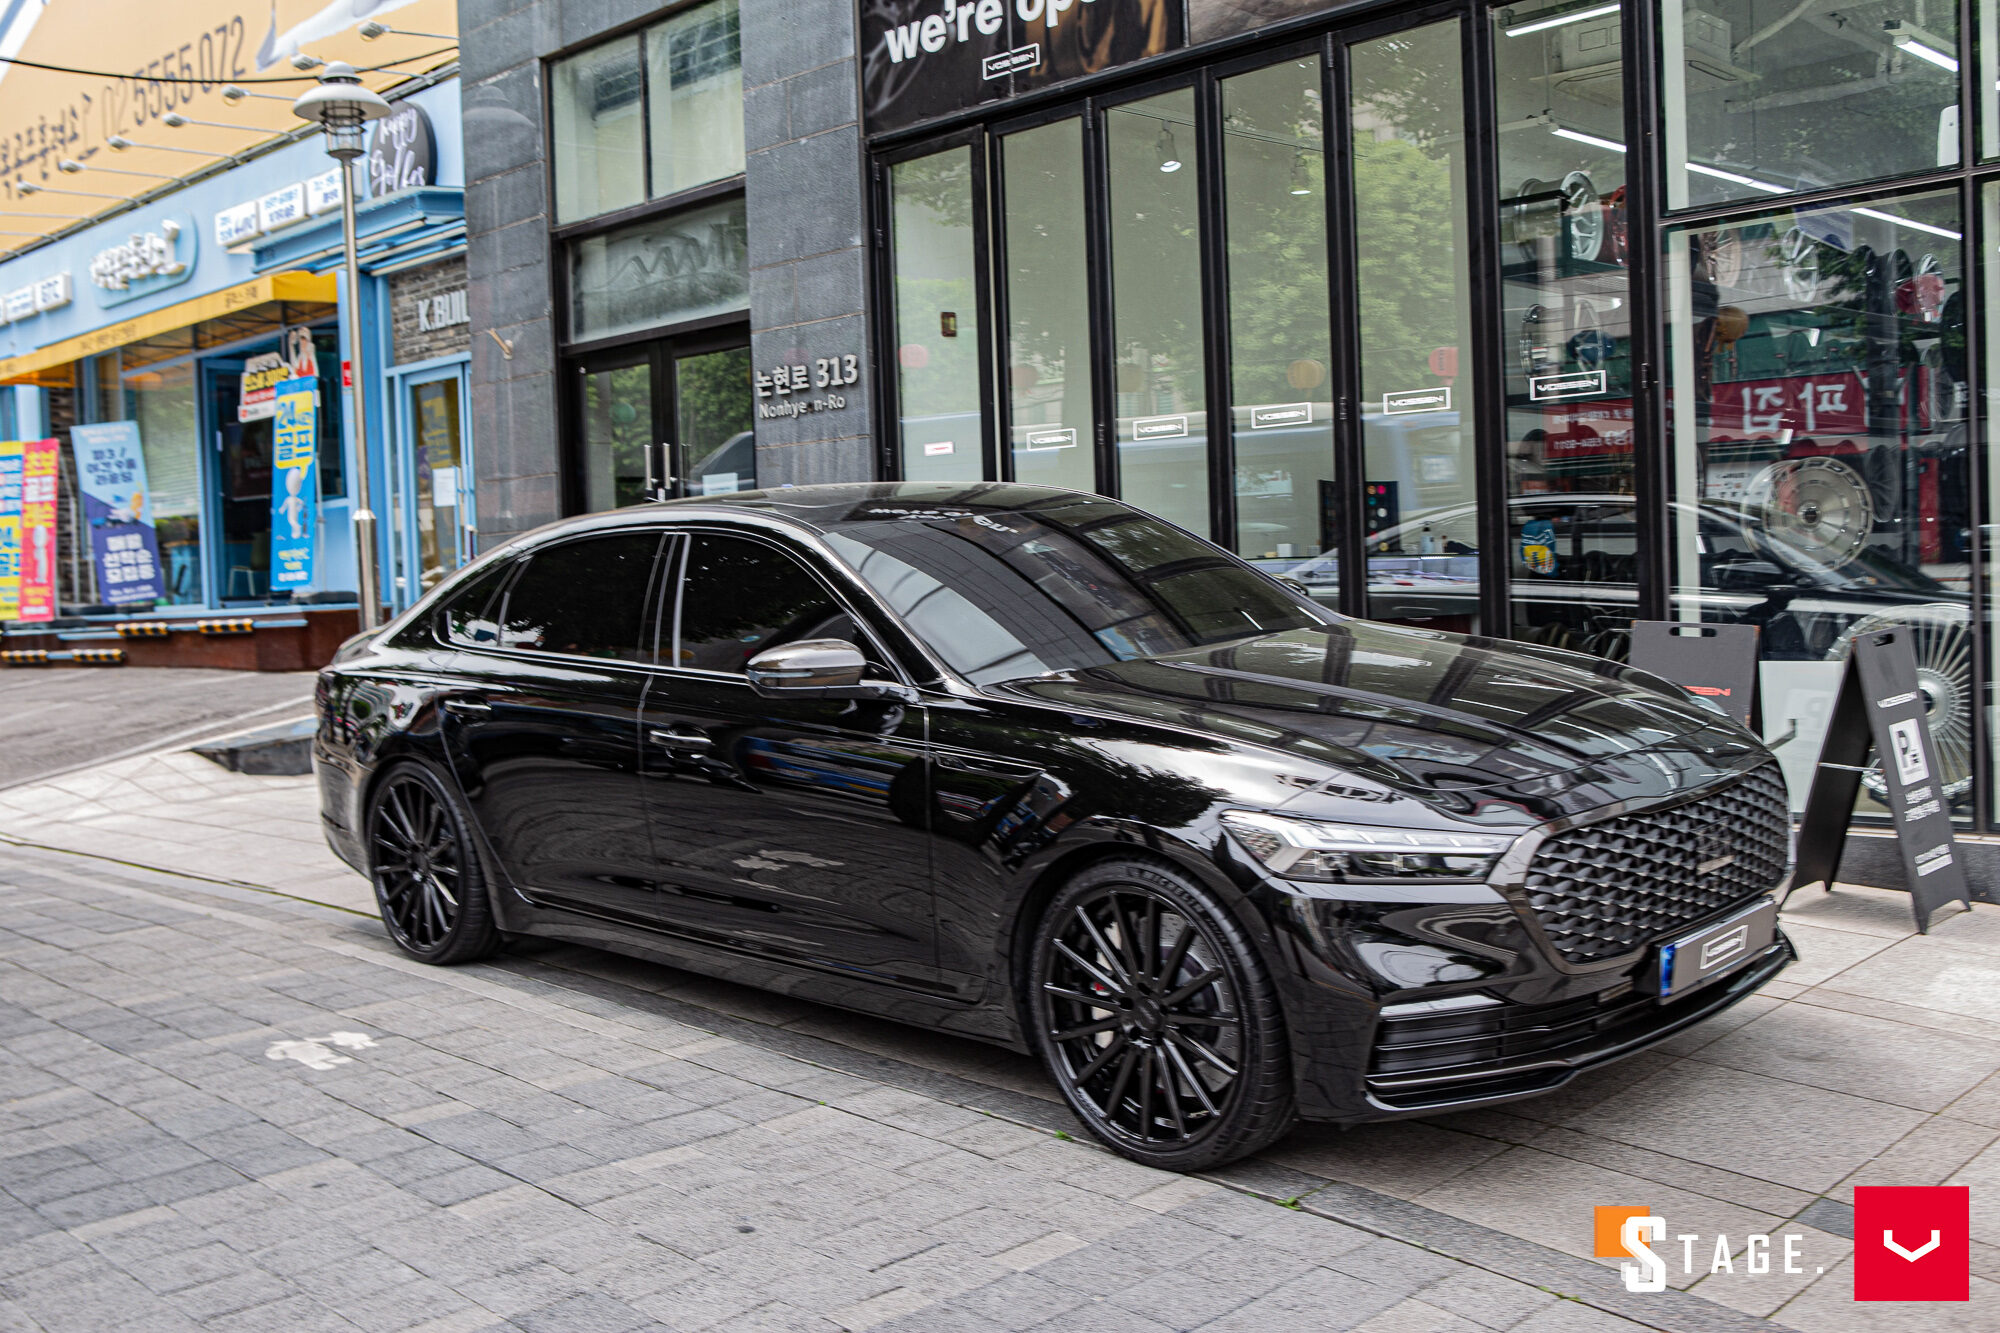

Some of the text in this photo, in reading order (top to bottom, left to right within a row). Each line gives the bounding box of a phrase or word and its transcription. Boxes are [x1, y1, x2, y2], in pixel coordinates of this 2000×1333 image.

[884, 0, 1097, 64] we're op
[755, 354, 858, 397] 논현로 313
[1536, 378, 1600, 393] VOSSEN
[758, 394, 845, 419] Nonhyen-Ro
[1389, 395, 1445, 408] VOSSEN
